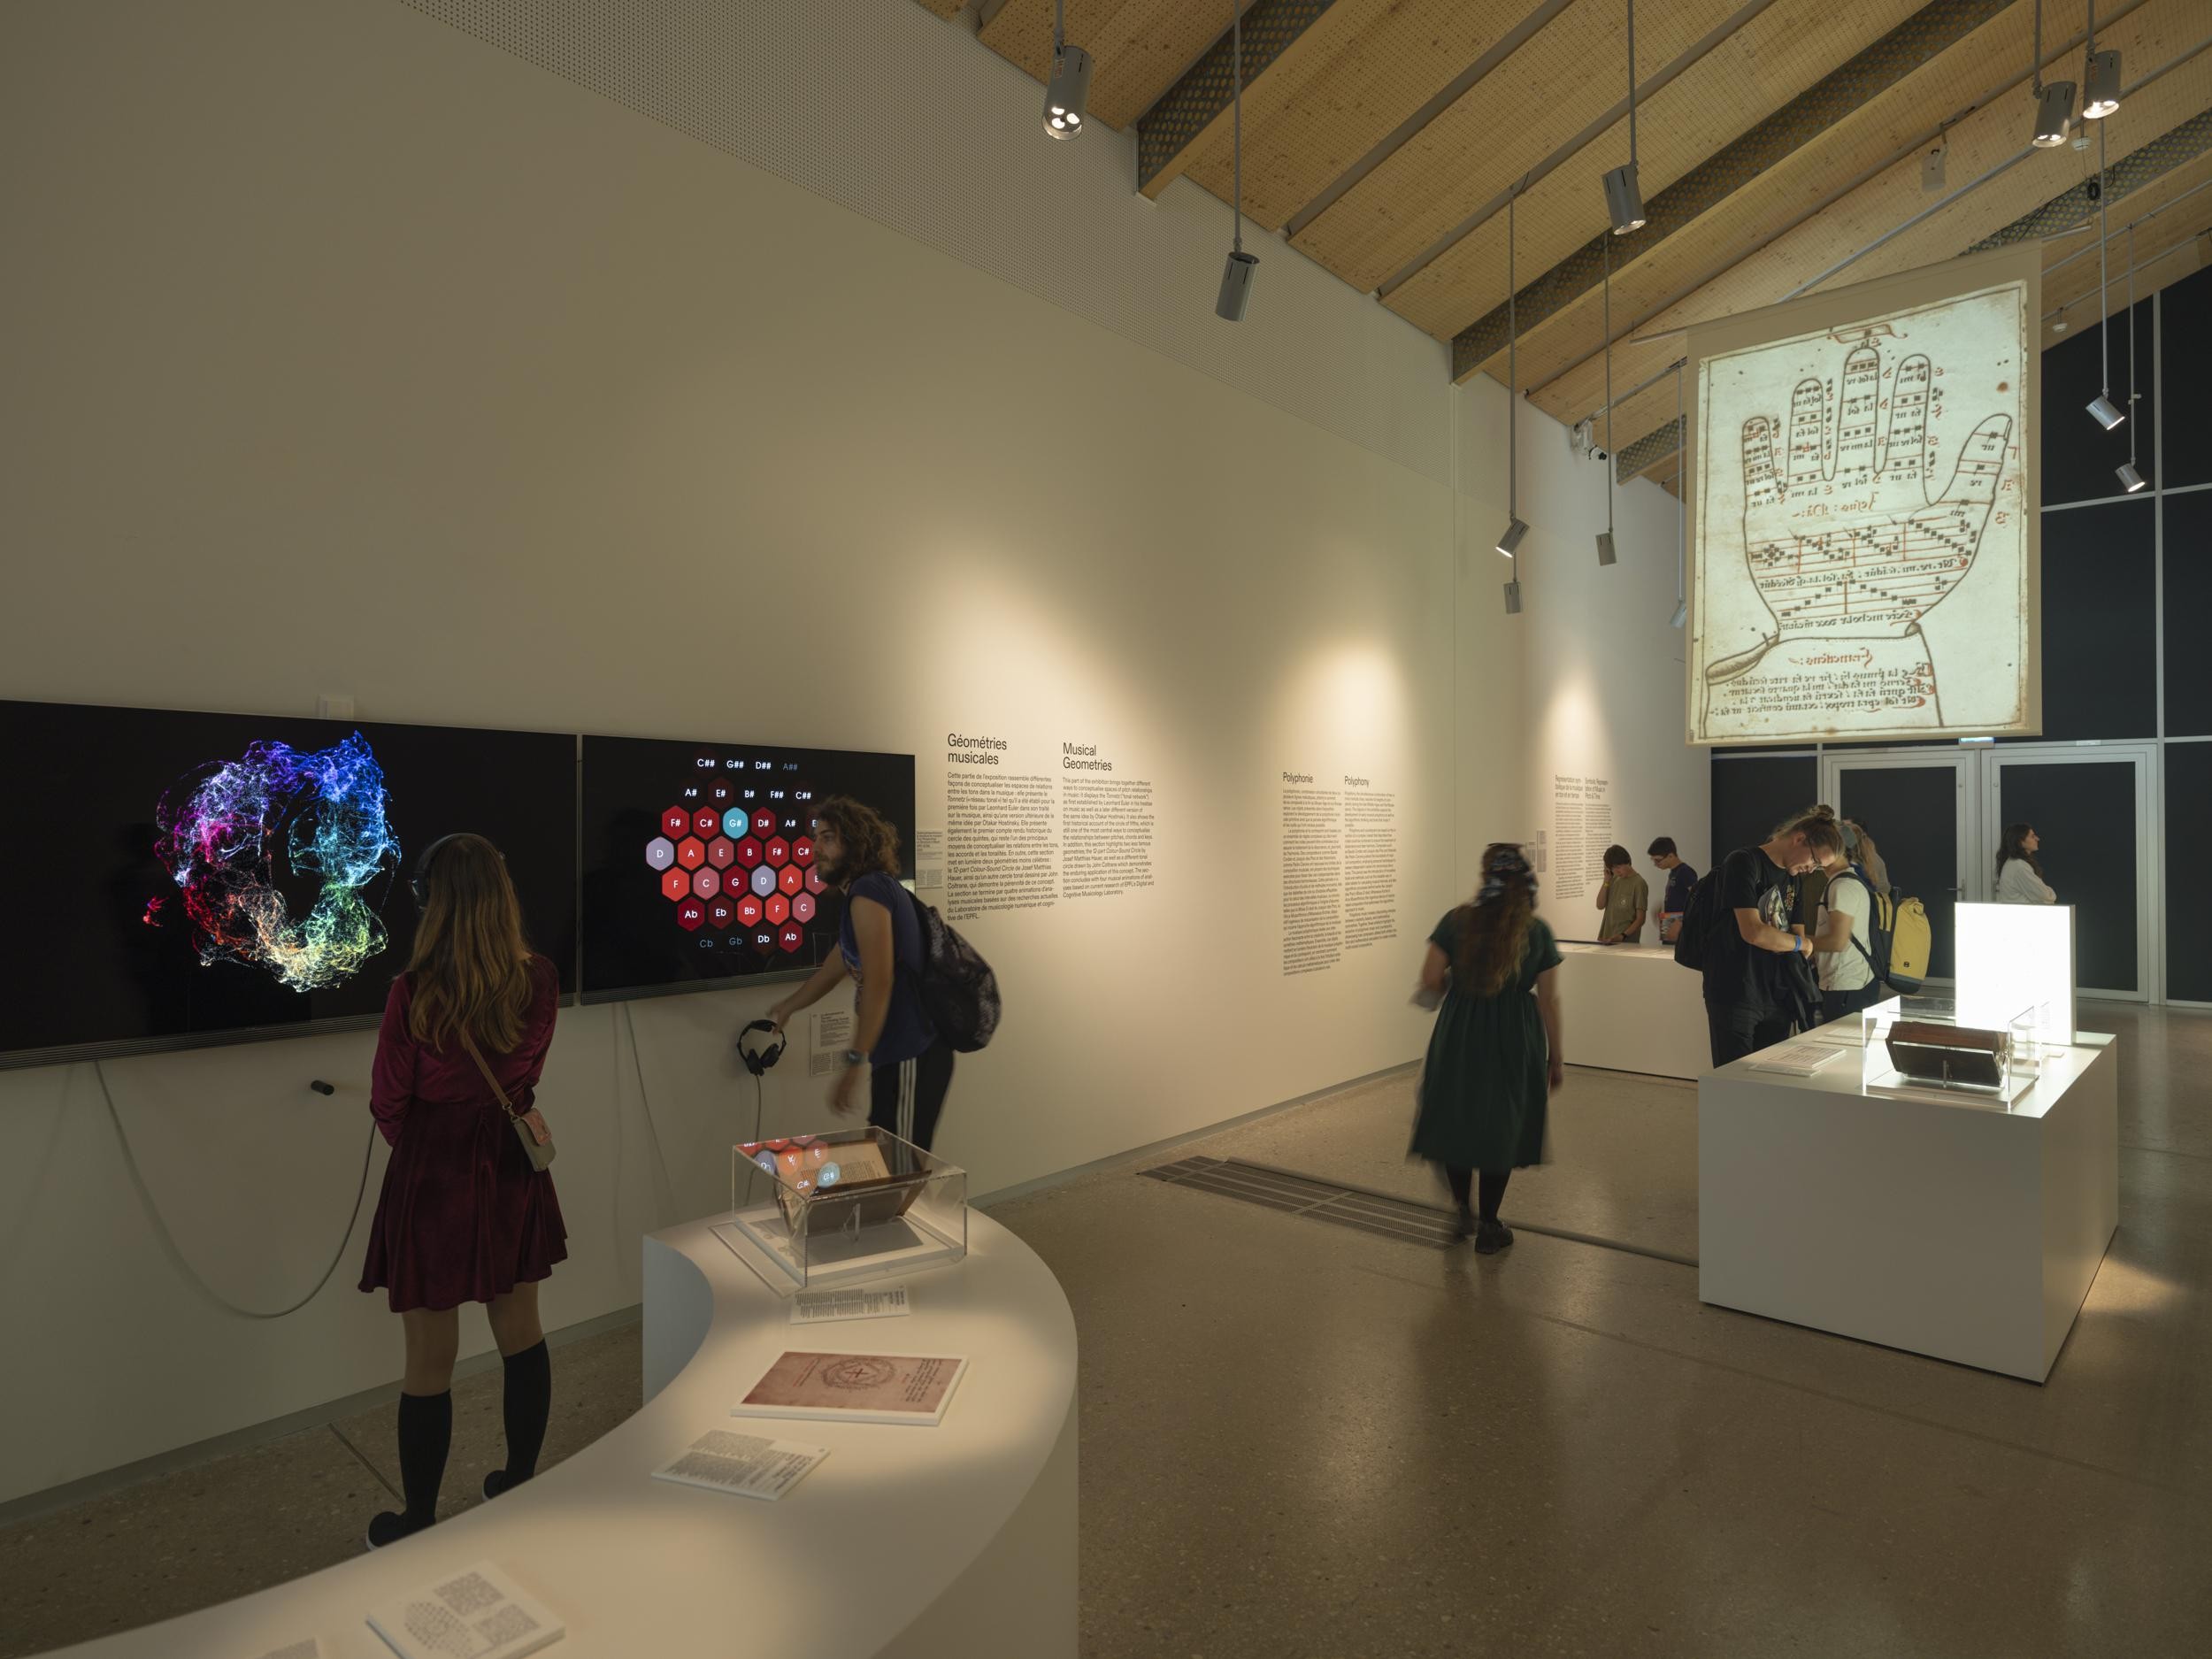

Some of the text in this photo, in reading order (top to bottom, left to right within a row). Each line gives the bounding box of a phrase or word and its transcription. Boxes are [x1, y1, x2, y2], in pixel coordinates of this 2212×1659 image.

[948, 733, 1008, 750] Géométries
[1063, 742, 1097, 757] Musical
[948, 750, 999, 765] musicales
[1063, 757, 1112, 772] Geometries
[1283, 772, 1313, 784] Polyphonie
[1345, 775, 1370, 787] Polyphony
